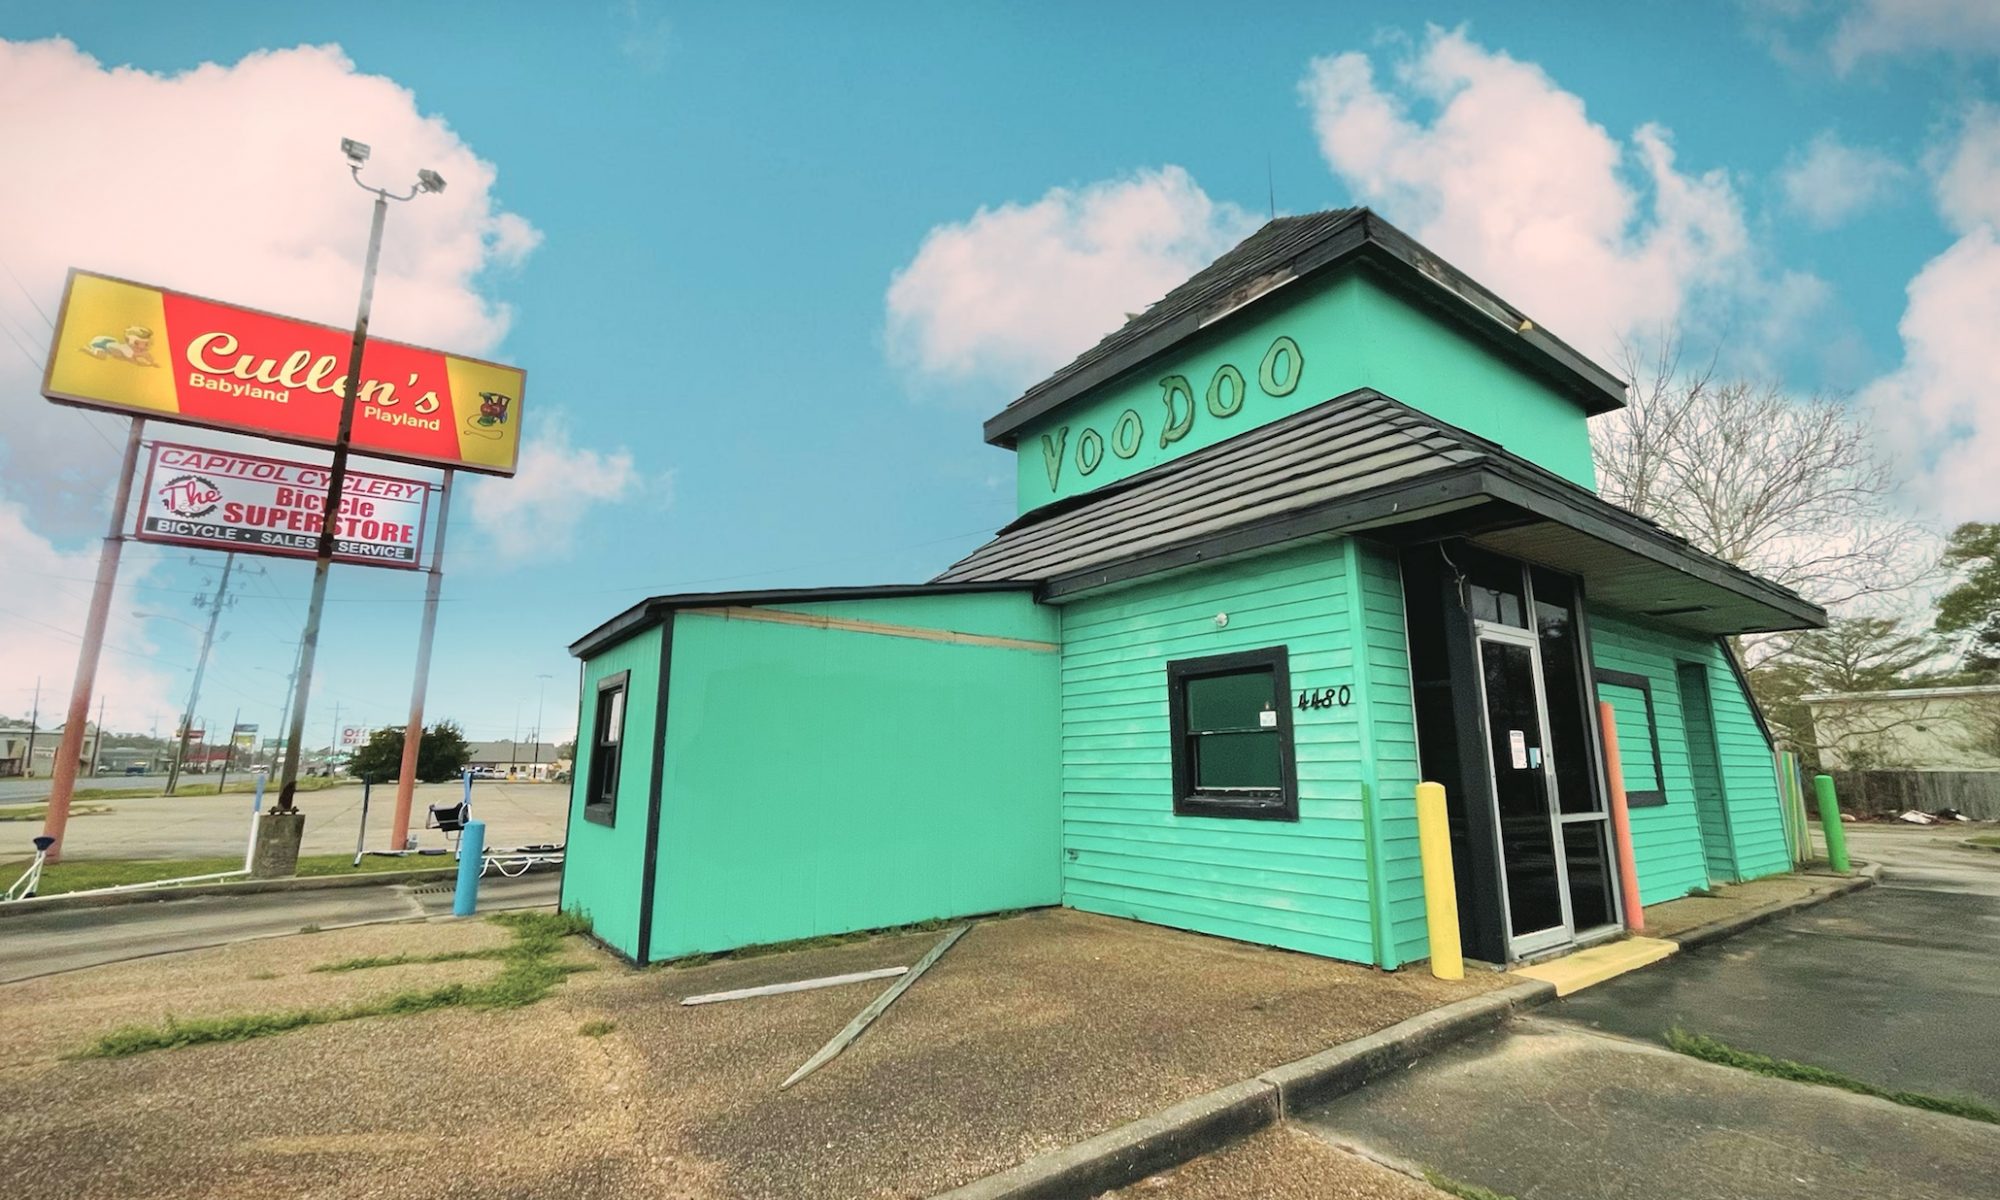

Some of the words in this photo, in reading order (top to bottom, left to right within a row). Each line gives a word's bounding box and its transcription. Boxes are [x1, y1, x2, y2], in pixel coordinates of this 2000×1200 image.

[186, 332, 440, 414] Cullen's
[189, 373, 289, 403] Babyland
[364, 406, 440, 431] Playland
[1041, 336, 1303, 493] VOODOO
[160, 450, 288, 481] CAPITOL
[159, 481, 223, 512] The
[157, 520, 237, 540] BICYCLE
[260, 532, 316, 549] SALES
[338, 541, 406, 559] SERVICE
[1298, 685, 1351, 711] 4480
